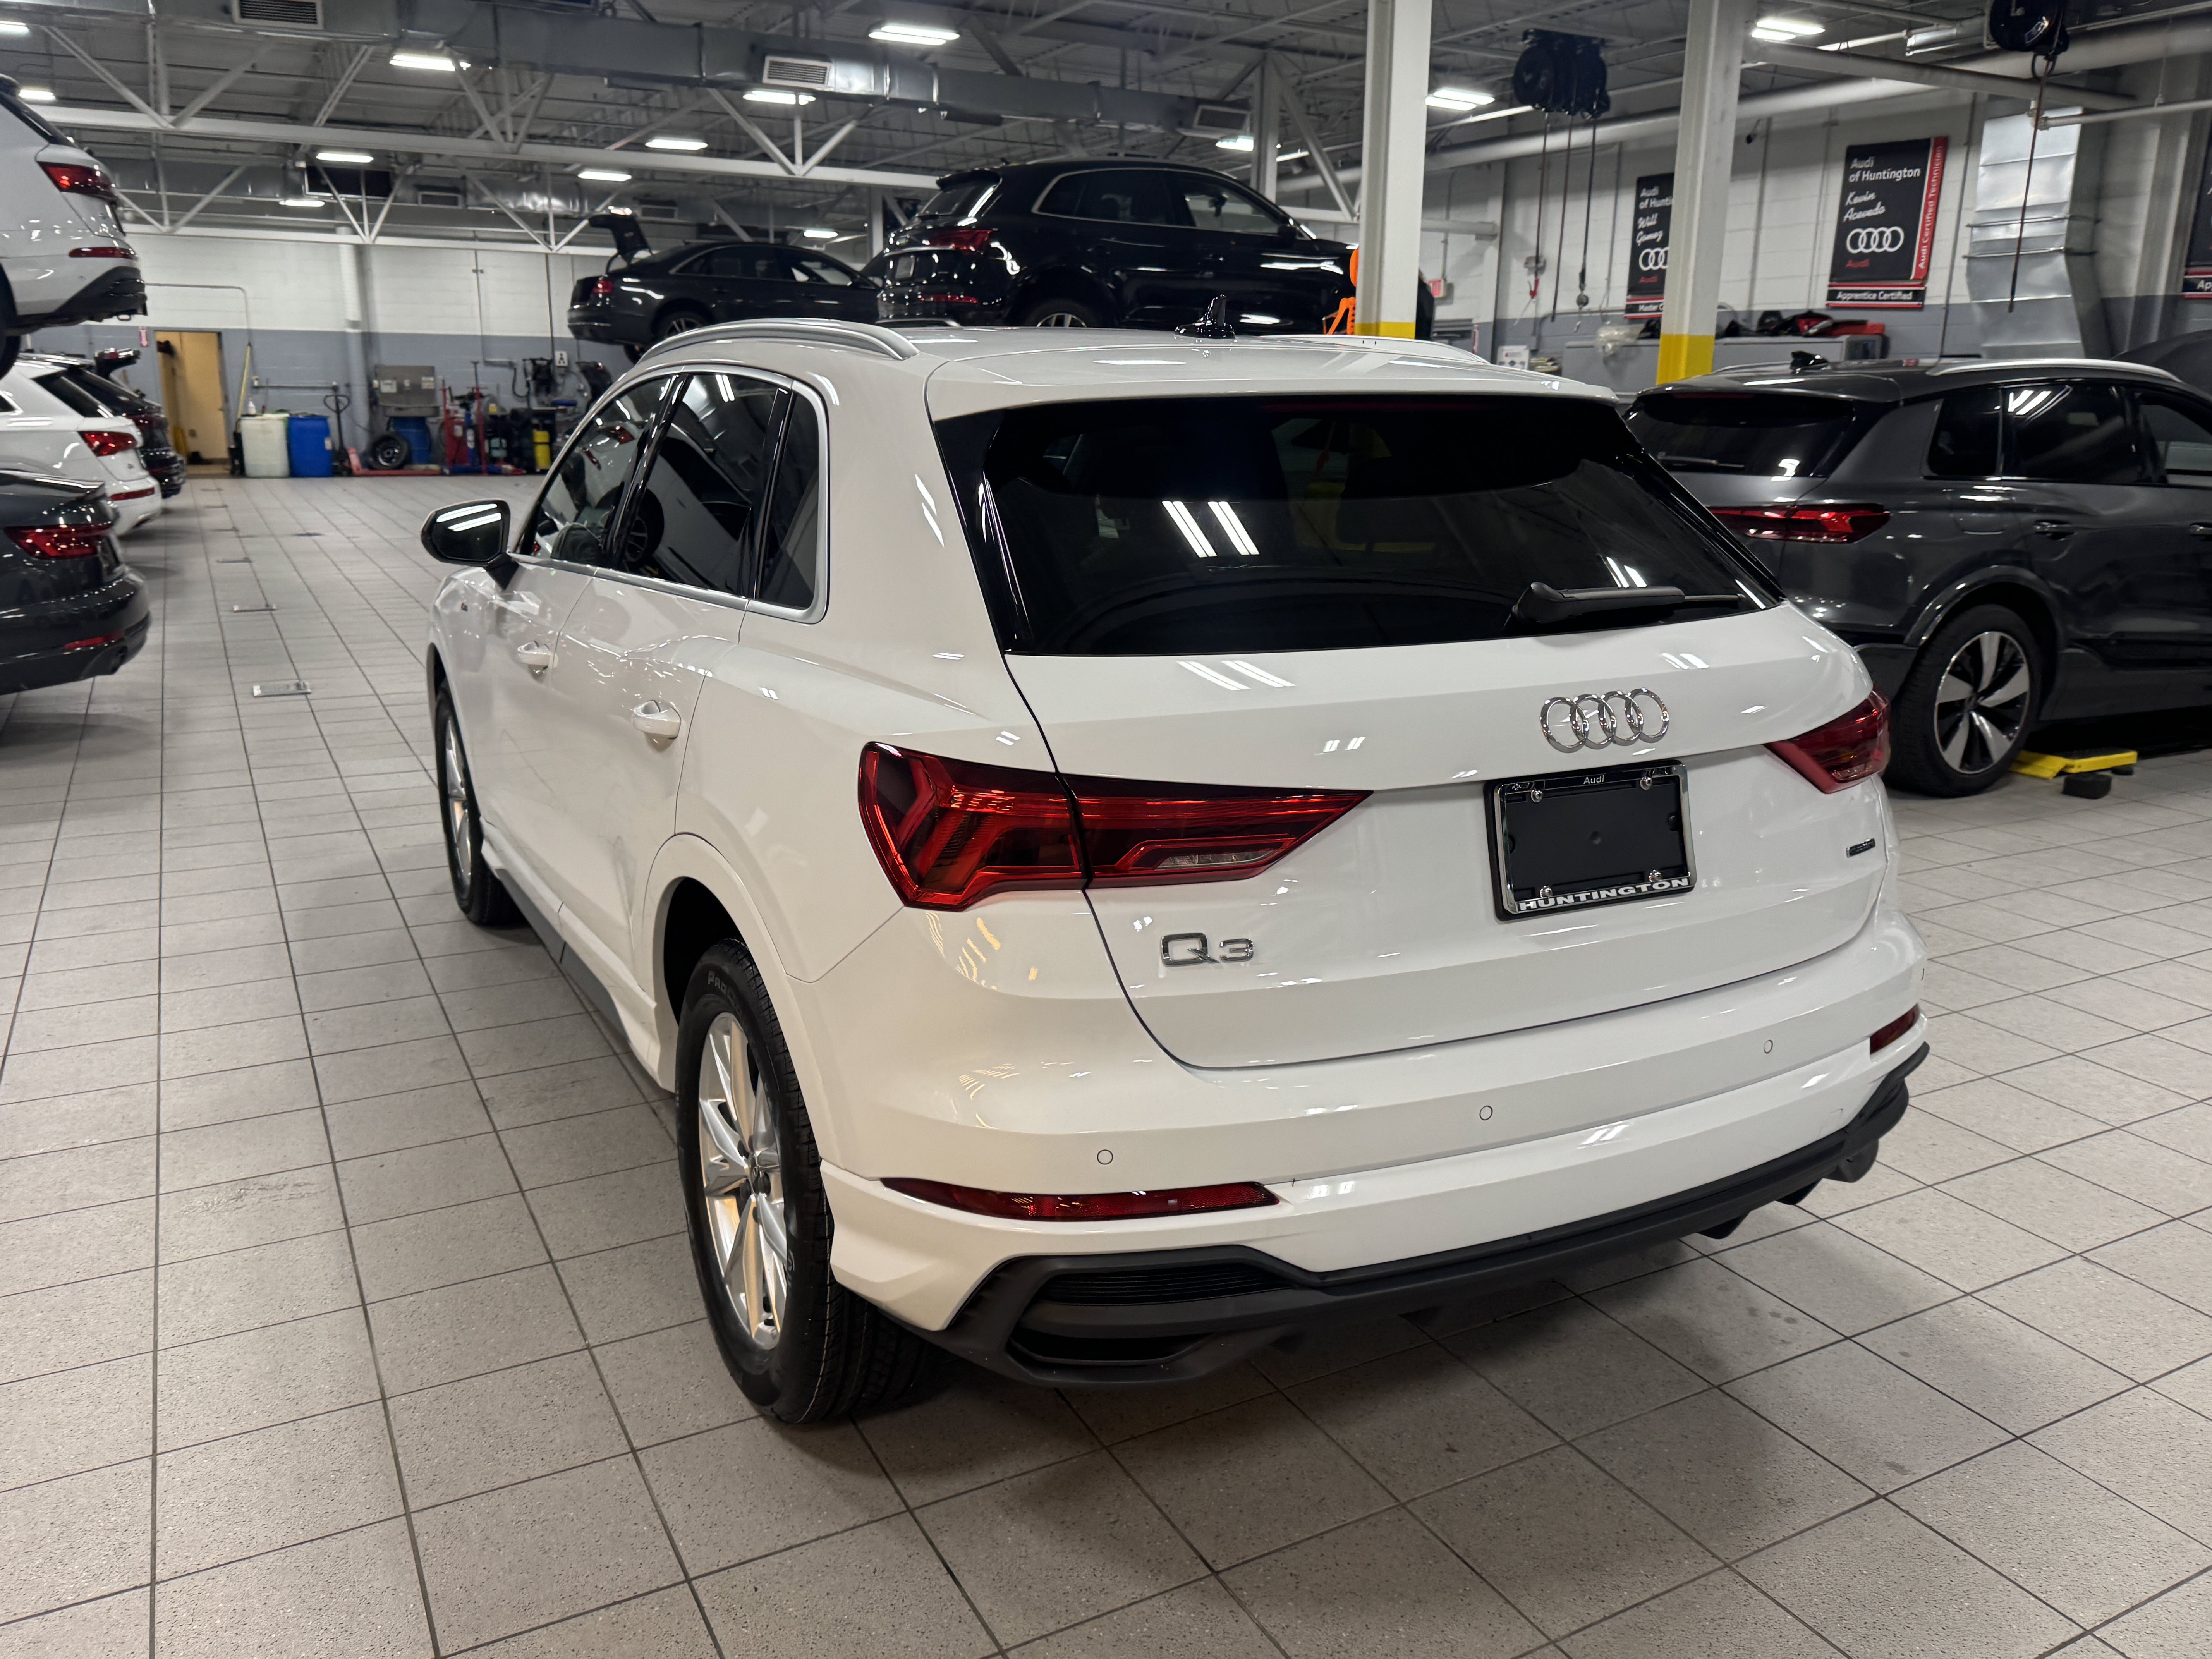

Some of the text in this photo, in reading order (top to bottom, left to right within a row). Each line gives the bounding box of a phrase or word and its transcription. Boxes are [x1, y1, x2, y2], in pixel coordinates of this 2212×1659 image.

[1850, 156, 1875, 169] Audi
[1849, 167, 1921, 182] of Huntington
[1640, 186, 1659, 197] Audi
[1639, 198, 1649, 209] of
[1918, 146, 1942, 269] Audi Certified Technician
[1583, 775, 1604, 784] Audi
[1520, 878, 1690, 911] HUNTINGTON
[1160, 932, 1254, 967] Q3
